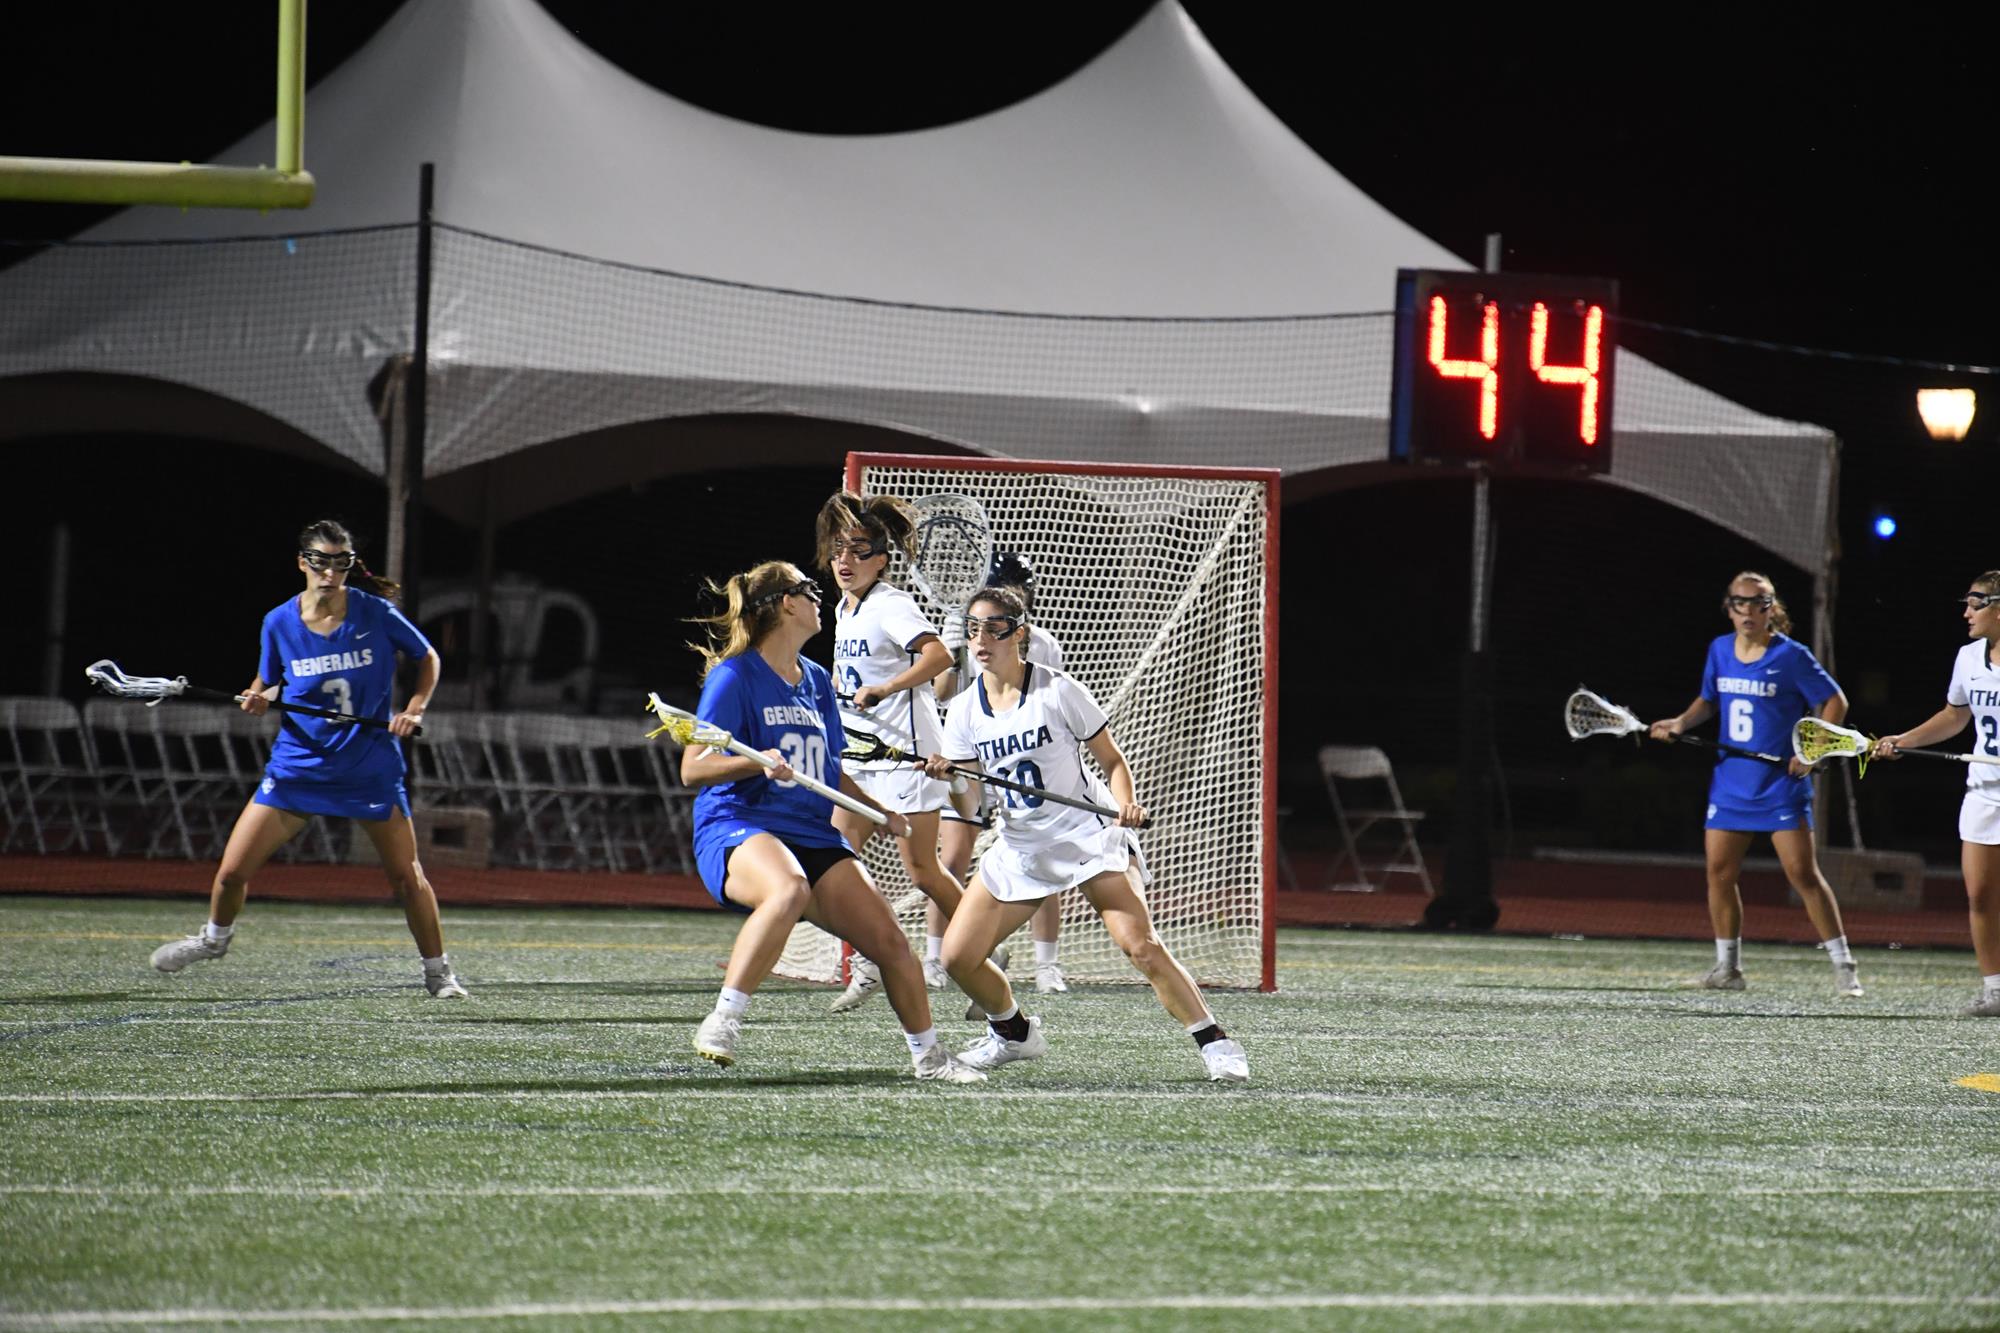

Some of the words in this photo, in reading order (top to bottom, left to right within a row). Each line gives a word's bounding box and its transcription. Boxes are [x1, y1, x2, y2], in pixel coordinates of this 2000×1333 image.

[1429, 296, 1603, 445] 44
[291, 648, 373, 677] GENERALS
[322, 678, 353, 723] 3
[1716, 677, 1778, 698] ENERALS
[1969, 689, 2000, 707] ITH
[1729, 699, 1754, 742] 6
[774, 732, 826, 790] 30
[996, 759, 1046, 809] 10
